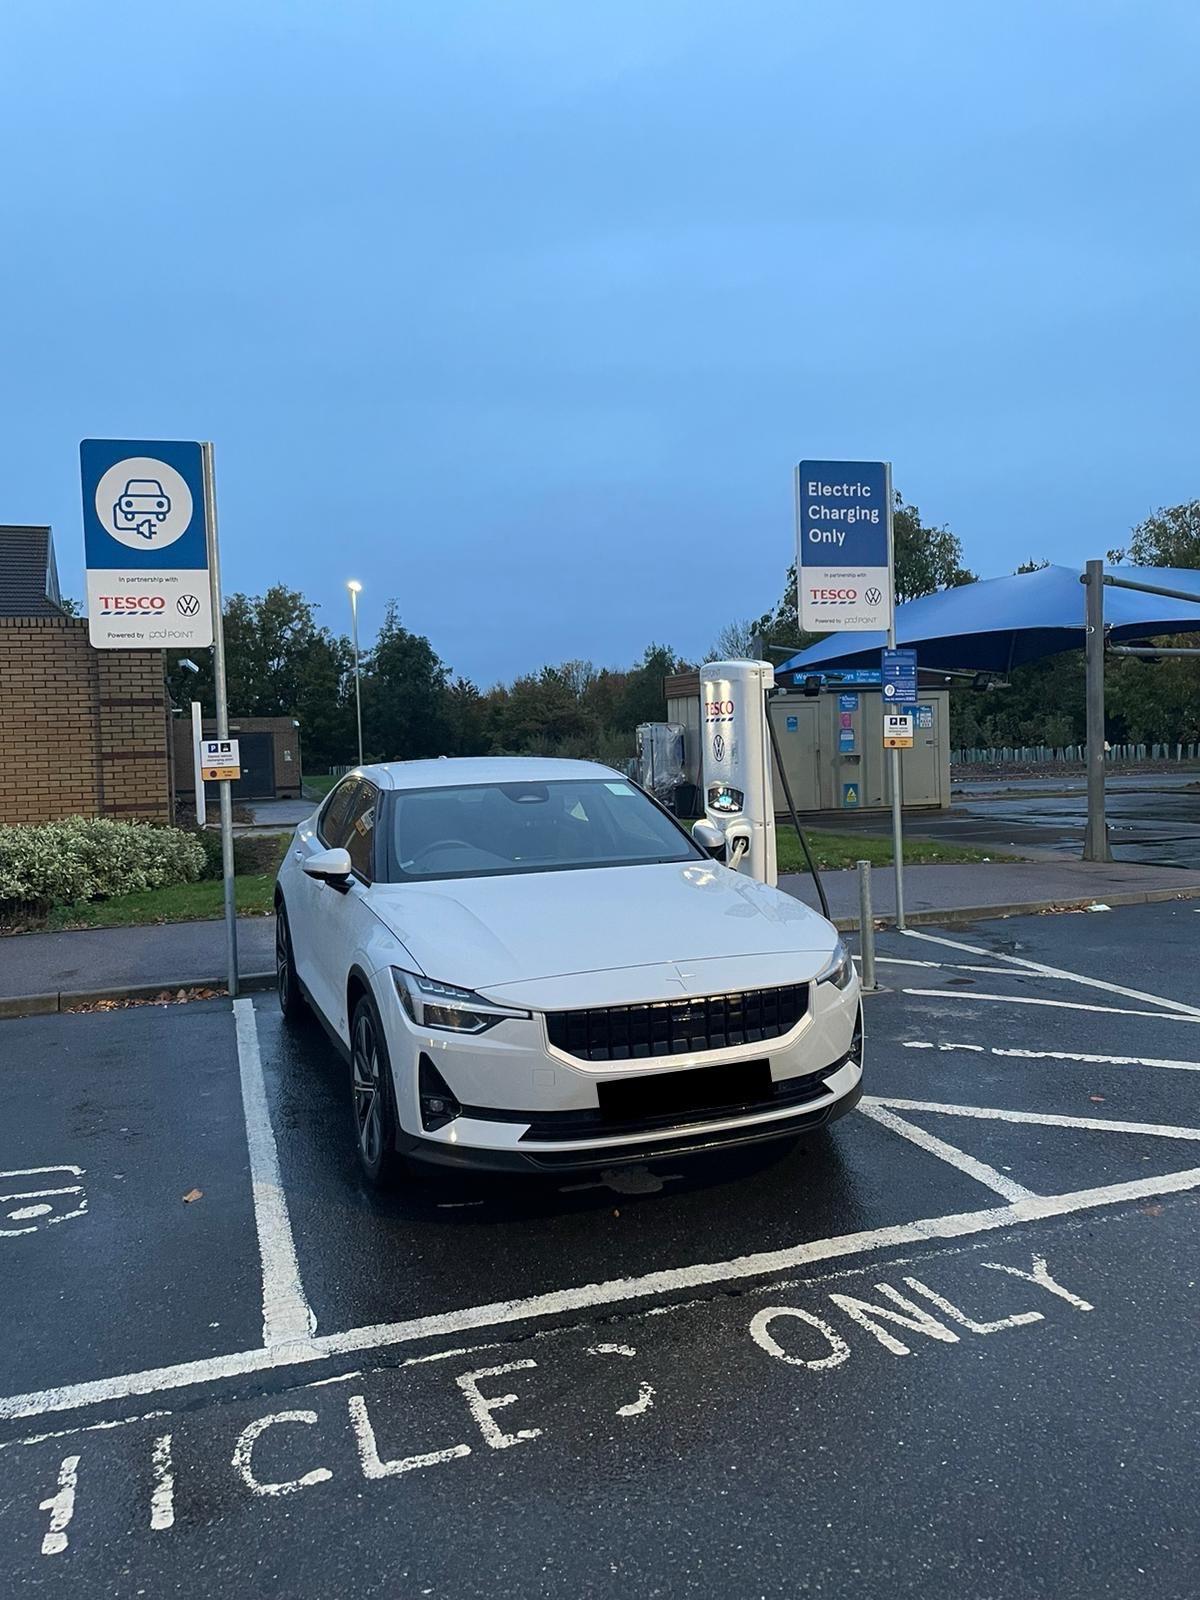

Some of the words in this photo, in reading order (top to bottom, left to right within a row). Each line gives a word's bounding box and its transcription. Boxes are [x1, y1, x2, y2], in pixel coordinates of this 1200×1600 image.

[808, 482, 871, 497] Electric
[808, 505, 880, 524] Charging
[809, 528, 845, 546] Only
[810, 589, 857, 600] TESCO
[99, 596, 165, 610] TESCO
[705, 700, 734, 715] TESCO
[750, 1252, 1095, 1371] ONLY
